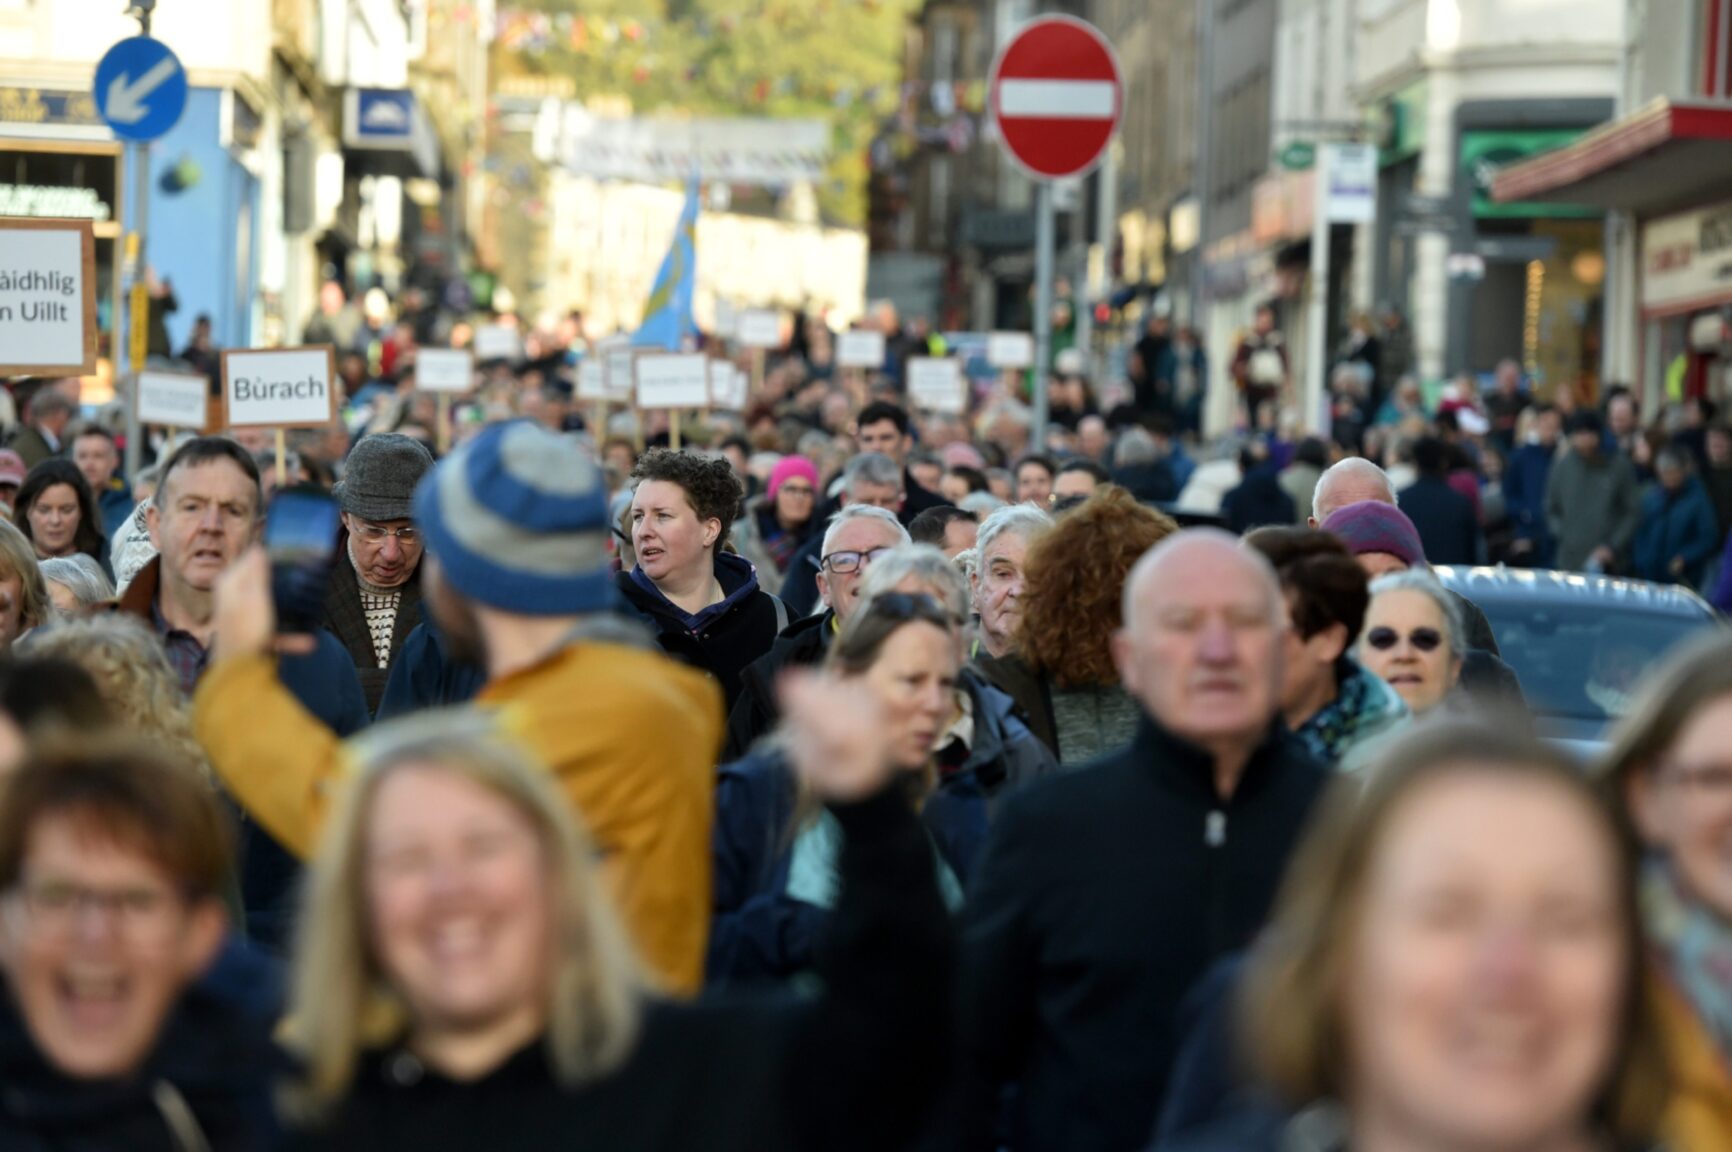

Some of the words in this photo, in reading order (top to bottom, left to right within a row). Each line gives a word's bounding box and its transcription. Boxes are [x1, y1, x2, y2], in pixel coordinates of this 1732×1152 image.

[0, 270, 75, 295] àidhlig
[20, 301, 68, 322] Uillt
[234, 373, 324, 402] Bùrach
